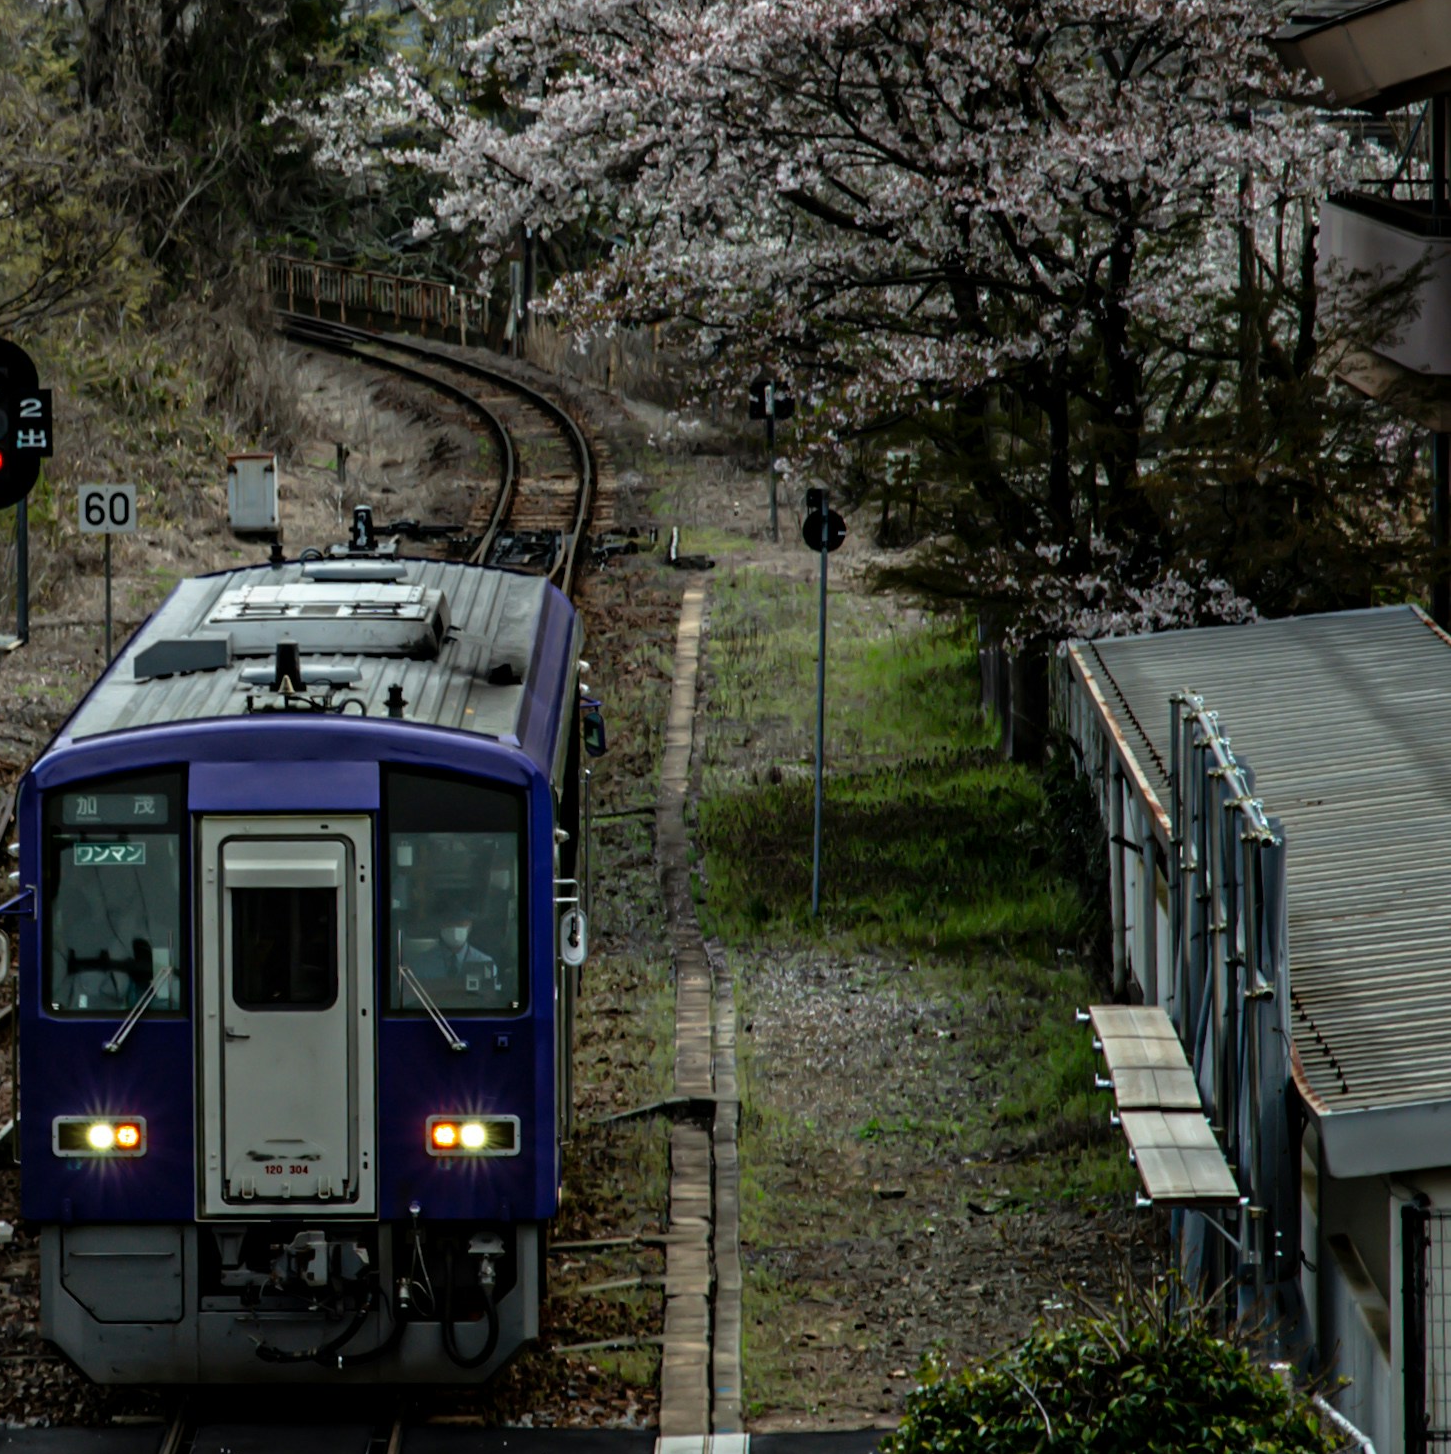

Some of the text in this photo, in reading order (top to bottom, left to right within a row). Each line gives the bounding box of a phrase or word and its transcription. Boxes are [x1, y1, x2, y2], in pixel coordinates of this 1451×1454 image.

[85, 492, 129, 526] 60
[77, 846, 142, 862] ワンマン
[265, 1165, 308, 1175] 120 304
